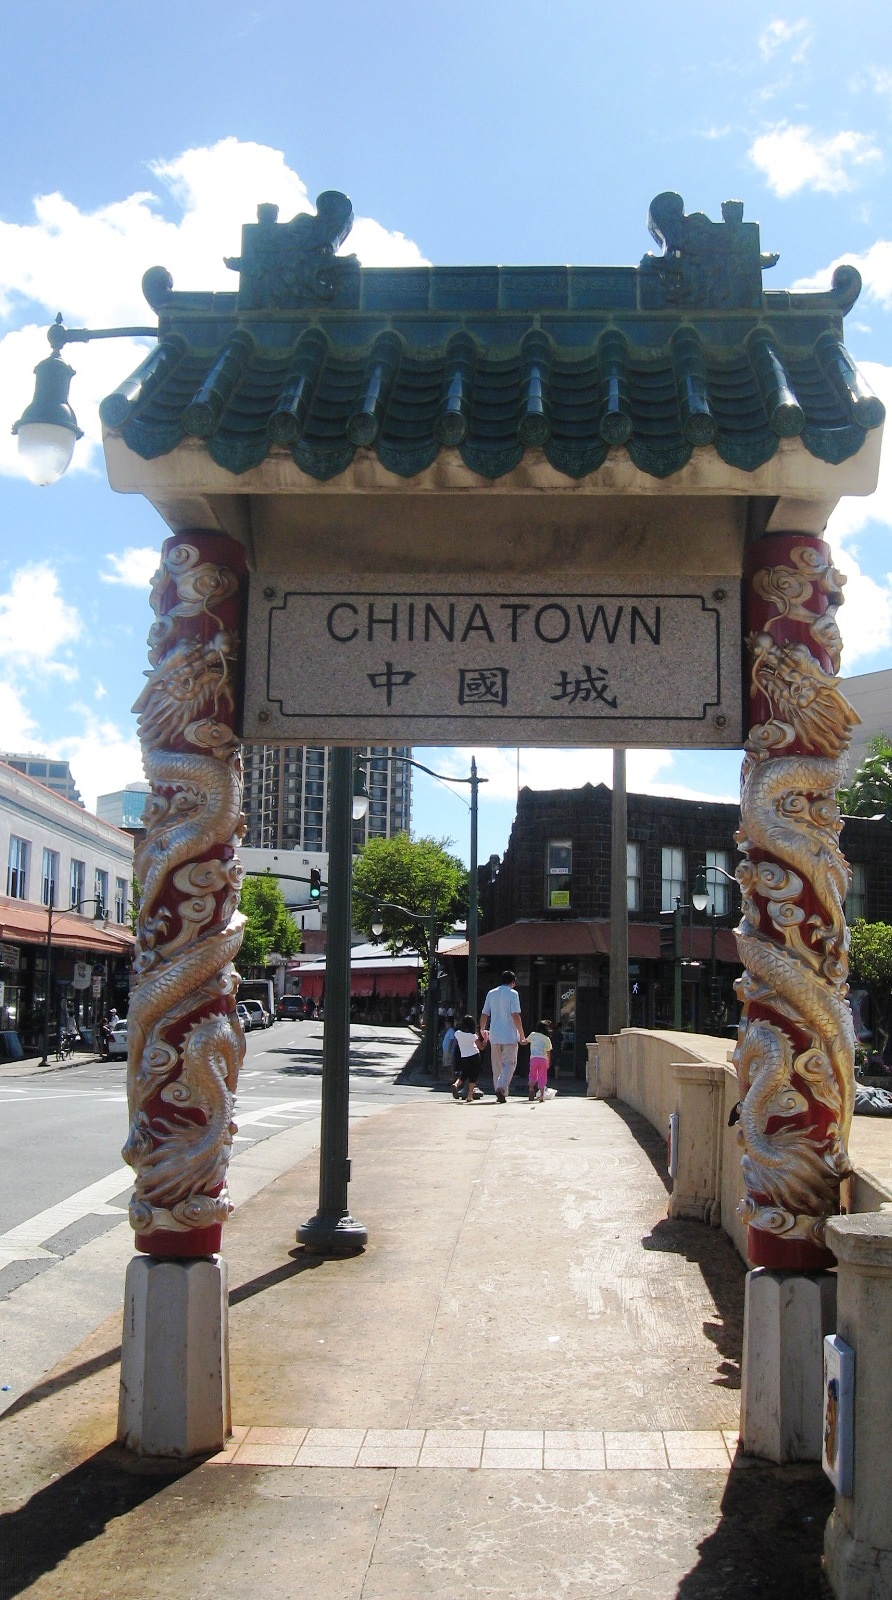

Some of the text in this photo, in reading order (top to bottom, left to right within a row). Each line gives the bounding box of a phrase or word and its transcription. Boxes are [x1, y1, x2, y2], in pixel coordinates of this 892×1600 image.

[327, 602, 661, 645] CHINATOWN
[367, 661, 618, 709] 中國城
